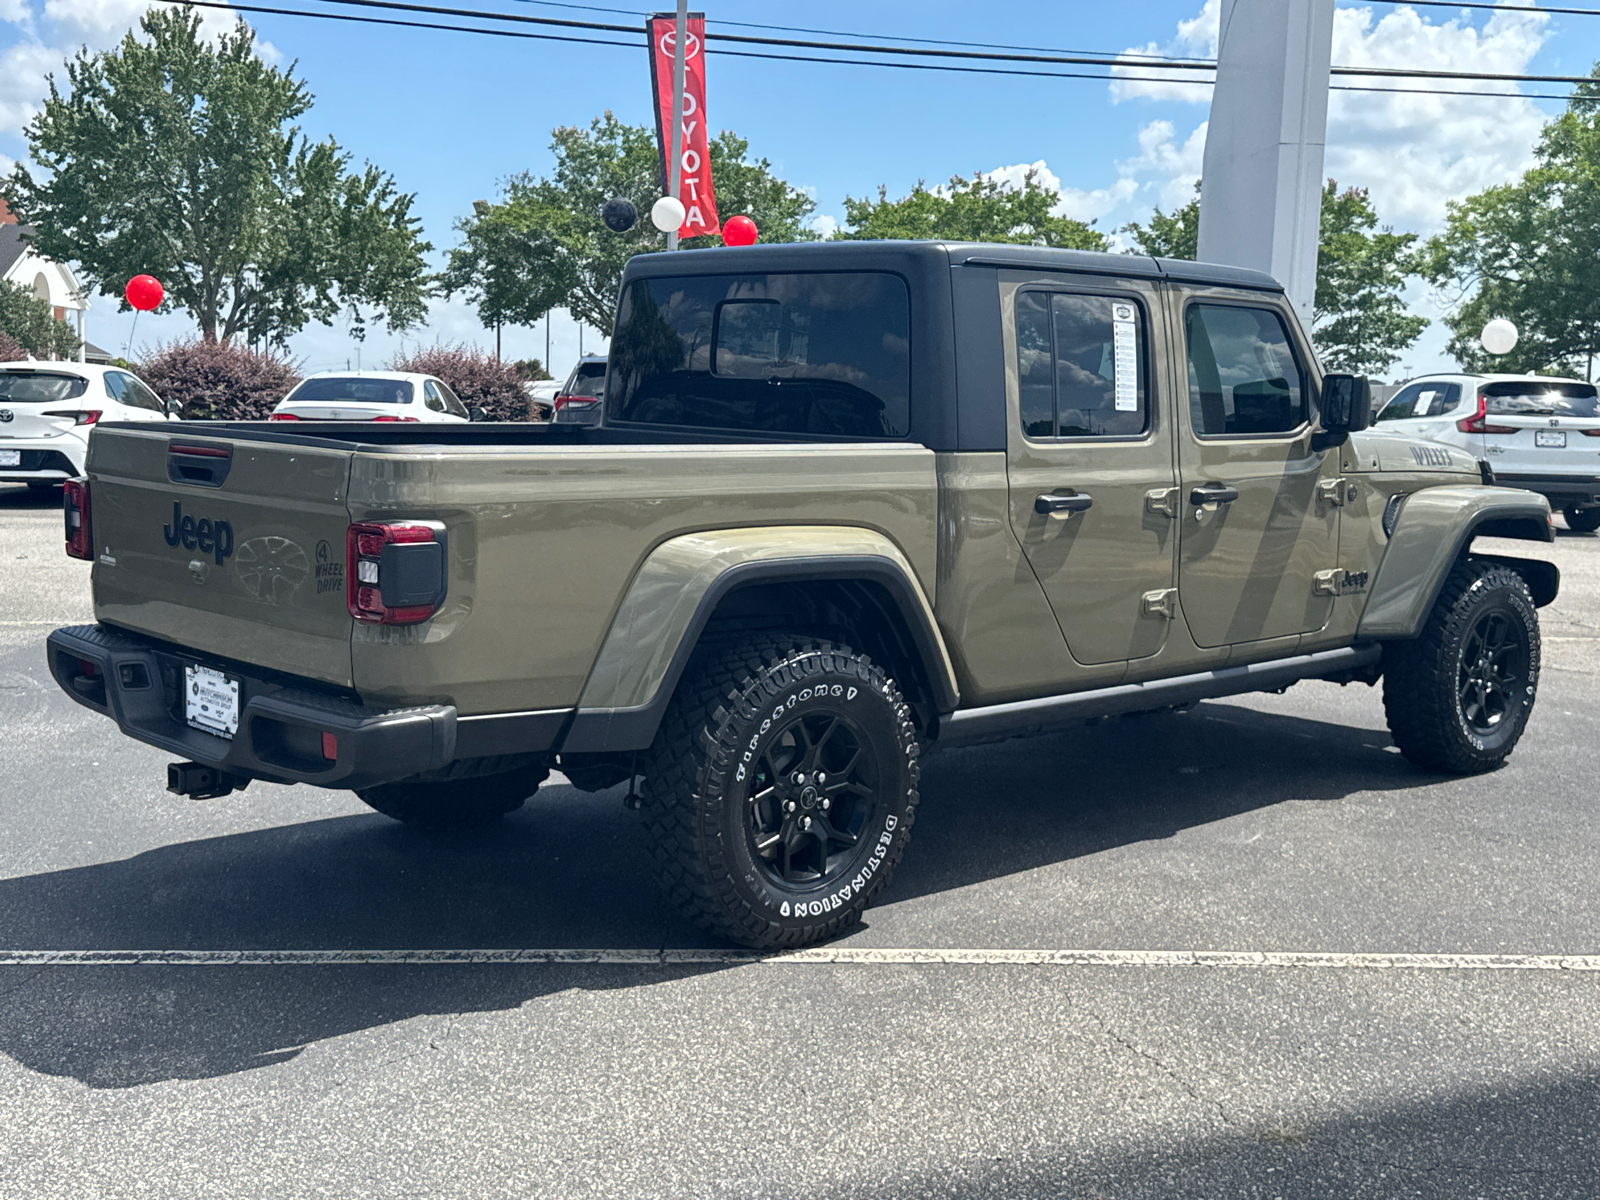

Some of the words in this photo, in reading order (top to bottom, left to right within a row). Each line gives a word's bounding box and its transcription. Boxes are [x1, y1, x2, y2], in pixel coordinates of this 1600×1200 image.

[673, 65, 705, 228] TOYOTA
[1409, 446, 1453, 466] WILLYS
[163, 500, 234, 566] Jeep
[315, 562, 343, 578] WHEEL
[1341, 569, 1368, 588] Jeep
[317, 577, 343, 594] DRIVE
[794, 815, 898, 917] DESTINATION
